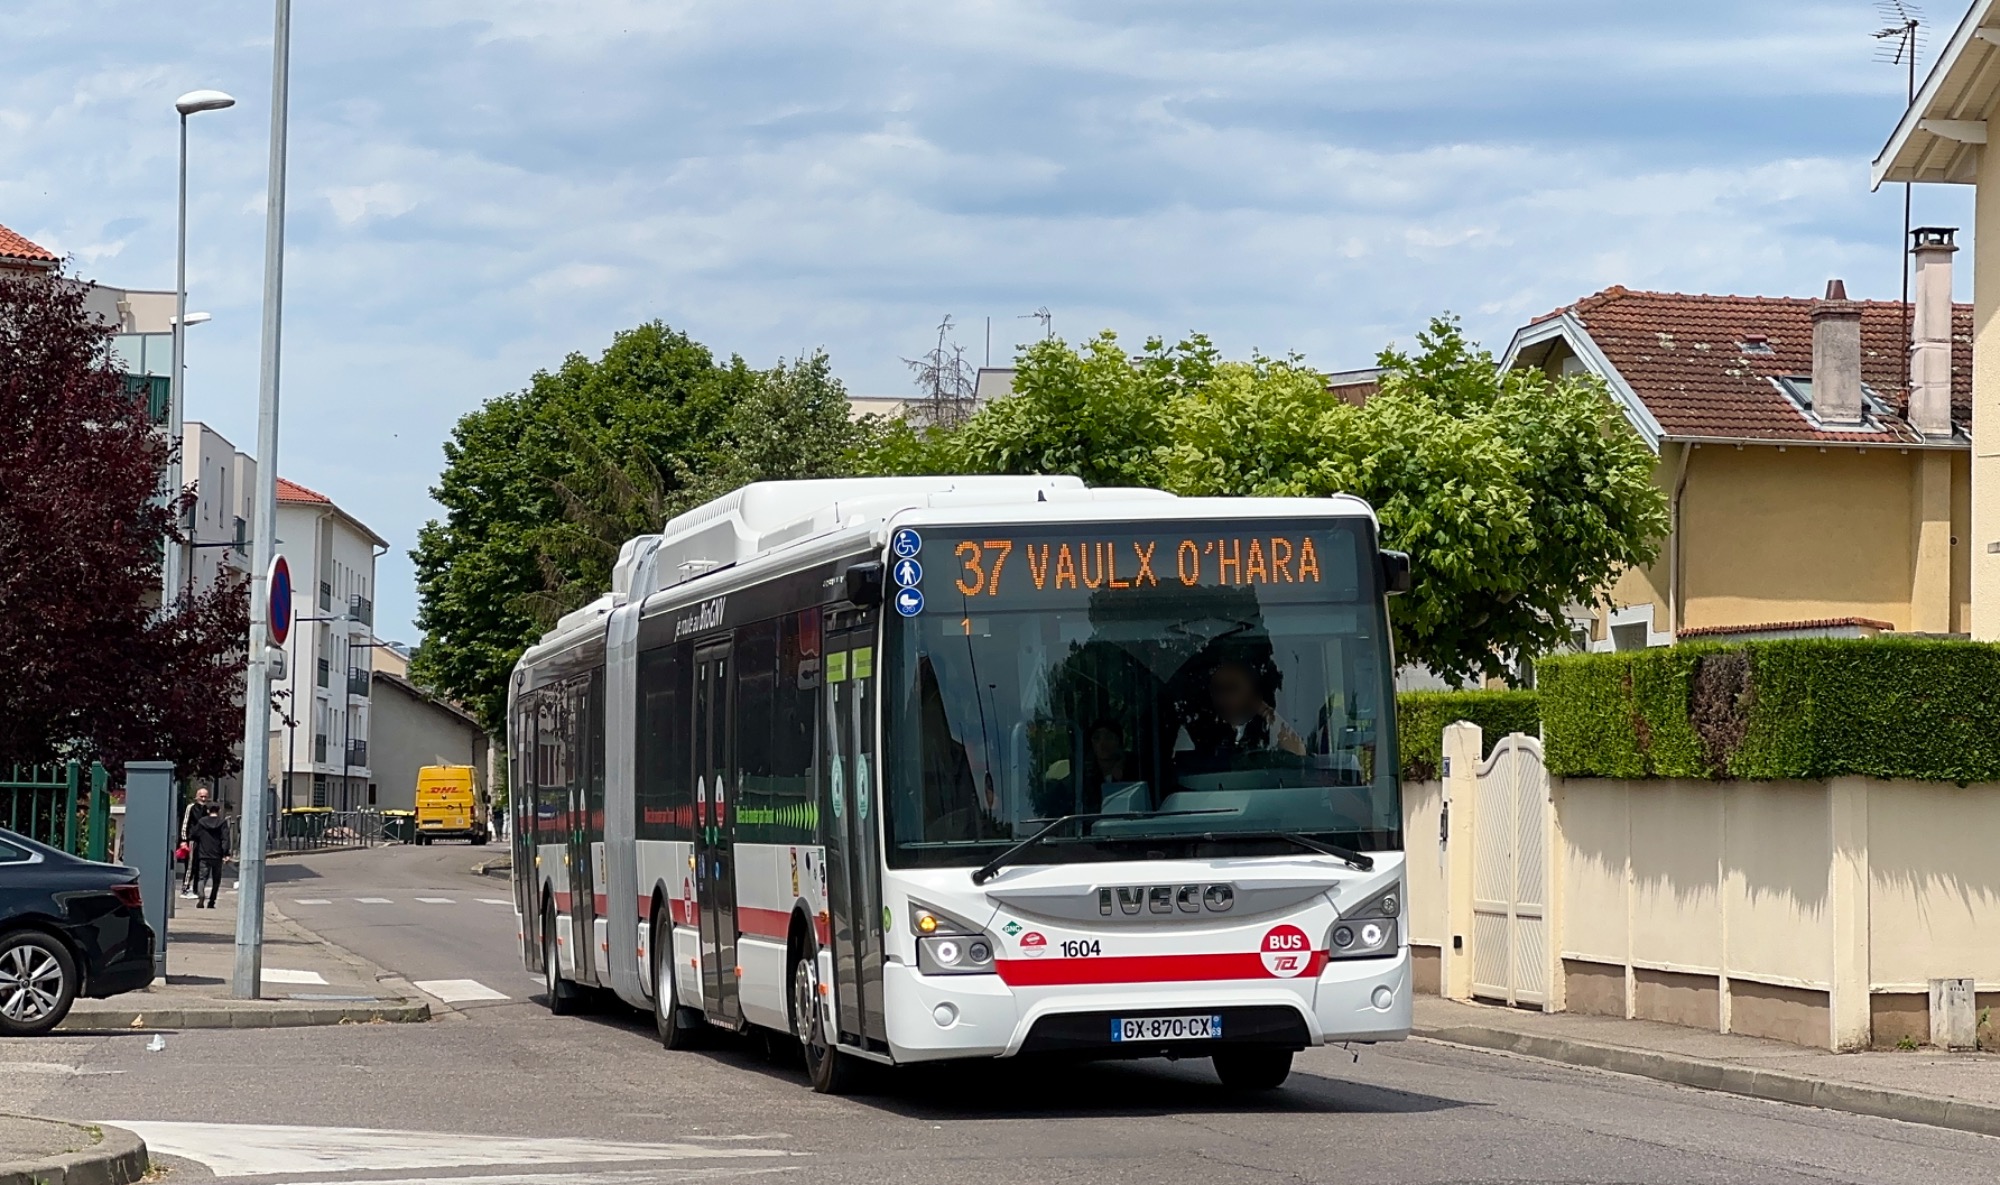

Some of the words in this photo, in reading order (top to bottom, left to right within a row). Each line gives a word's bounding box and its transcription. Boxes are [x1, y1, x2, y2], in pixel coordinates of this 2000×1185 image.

[955, 540, 1012, 596] 37
[1027, 541, 1156, 590] VAULX
[1177, 537, 1320, 586] O'HARA
[961, 618, 970, 636] 1
[430, 786, 459, 794] DHL
[1099, 885, 1234, 916] IVECO
[1060, 940, 1101, 957] 1604
[1269, 935, 1302, 950] BUS
[1124, 1018, 1210, 1039] GX-870-CX
